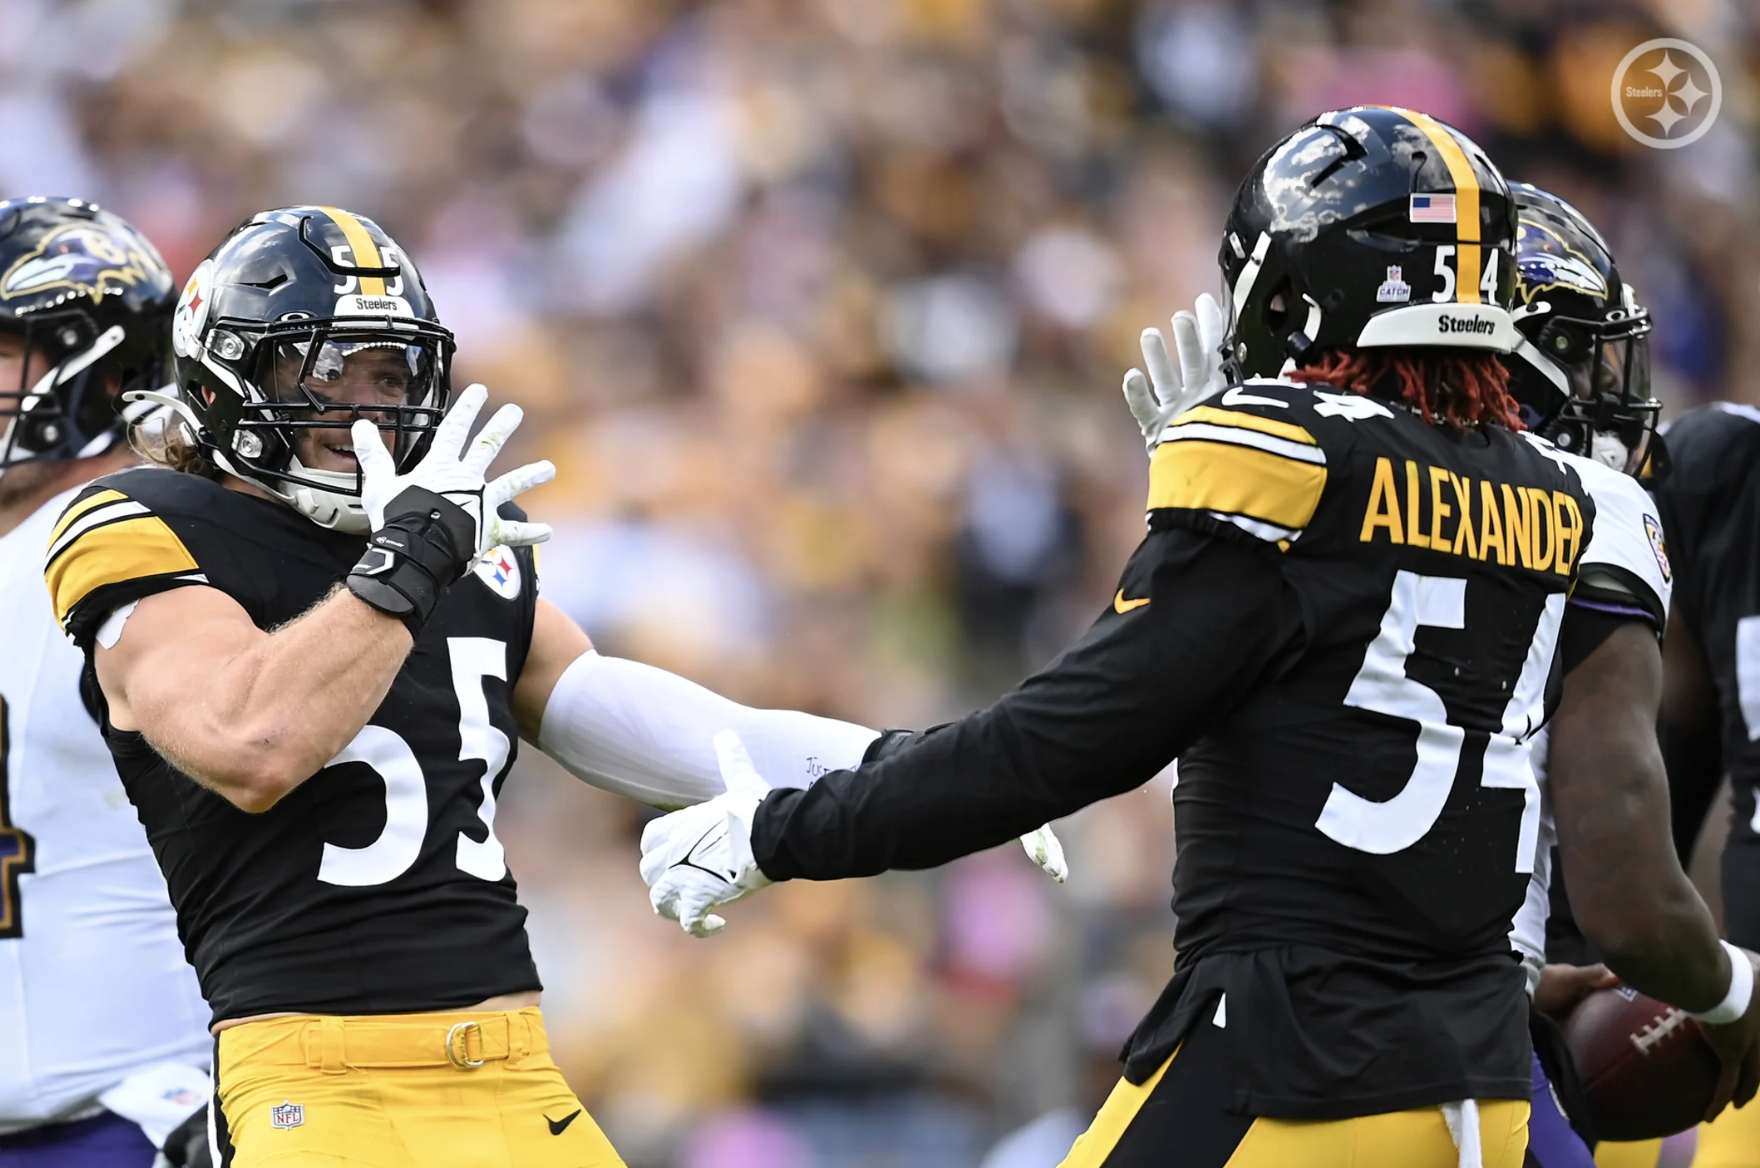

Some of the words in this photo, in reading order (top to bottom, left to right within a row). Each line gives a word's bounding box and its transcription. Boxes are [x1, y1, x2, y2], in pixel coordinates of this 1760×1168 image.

[1432, 245, 1499, 305] 54
[356, 298, 397, 311] Steelers
[1438, 314, 1495, 335] Steelers
[1315, 570, 1566, 874] 54
[277, 1112, 299, 1124] NFL
